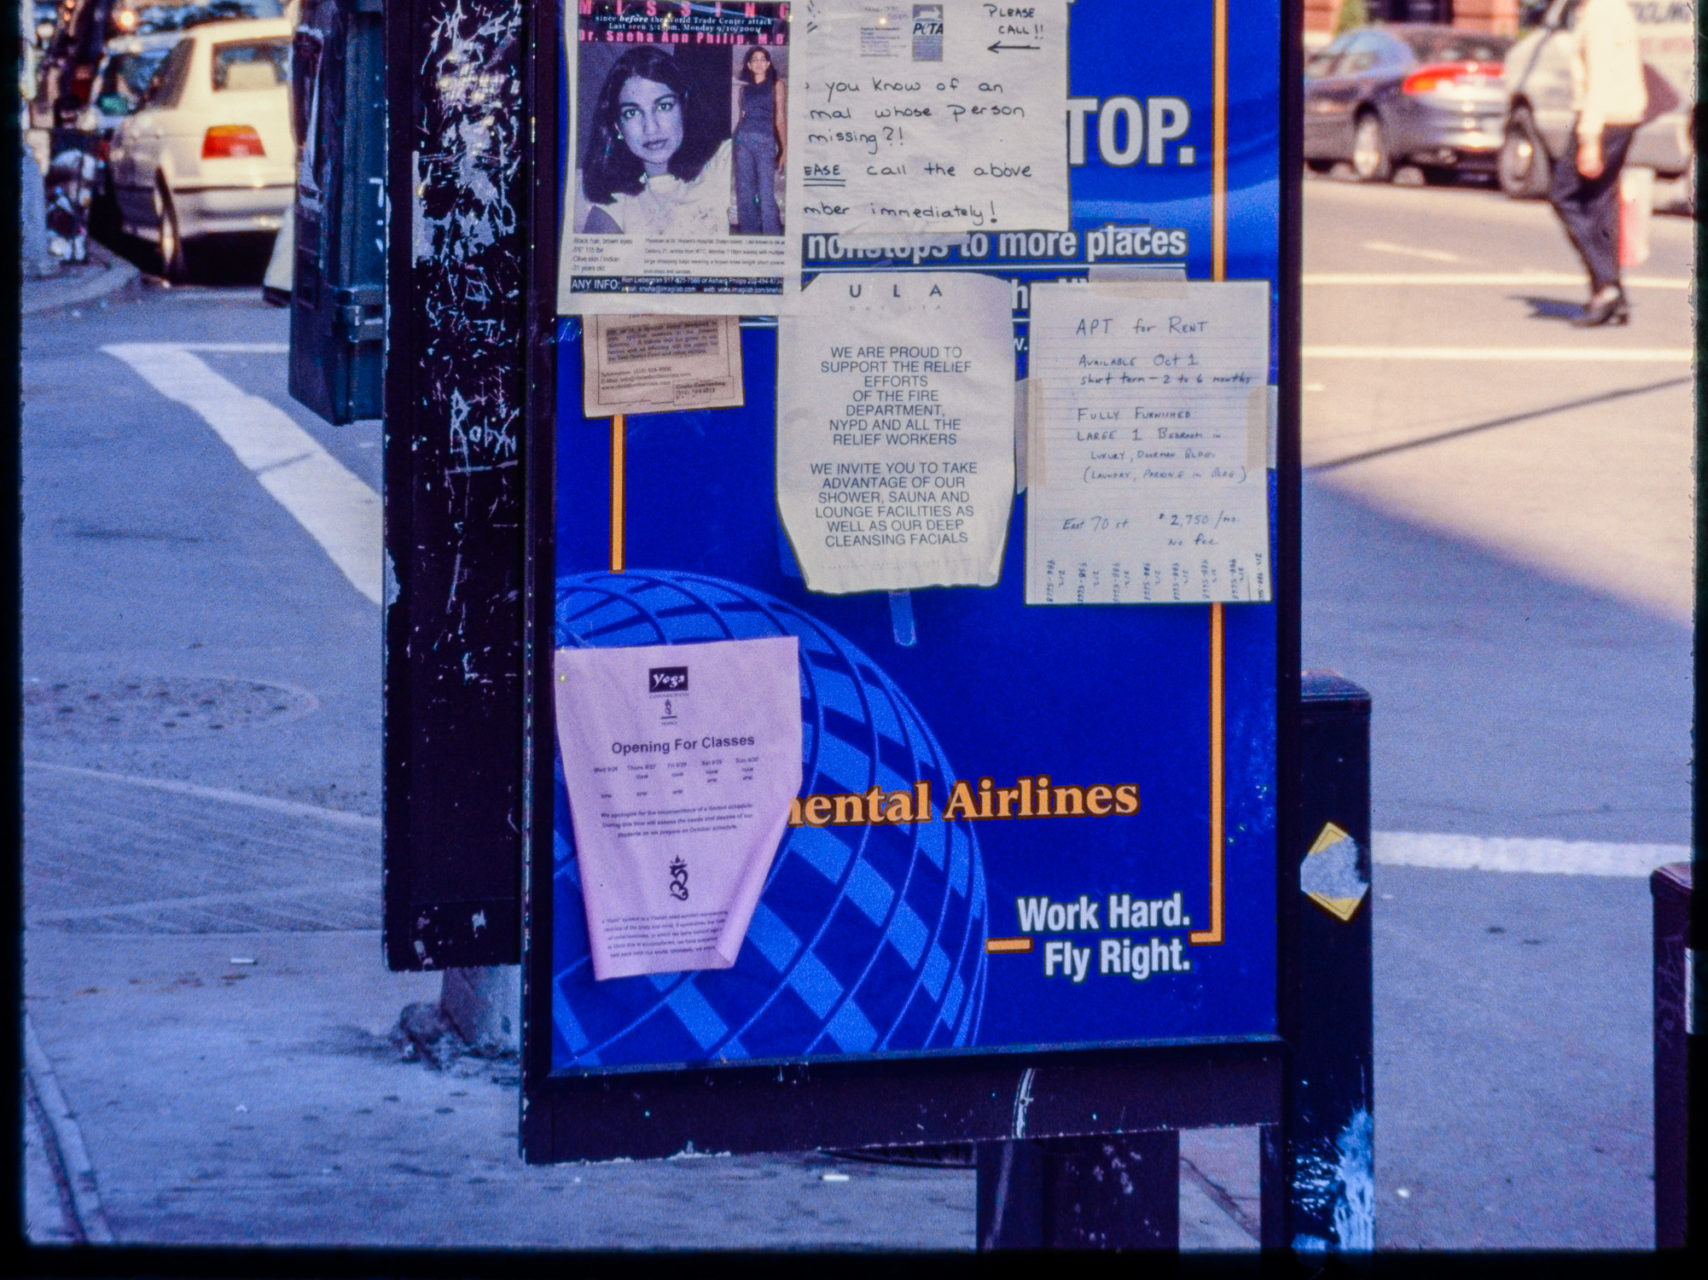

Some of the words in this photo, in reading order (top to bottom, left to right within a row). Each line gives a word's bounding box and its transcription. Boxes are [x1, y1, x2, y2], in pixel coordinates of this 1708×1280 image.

[983, 4, 1035, 18] PLEASE
[619, 14, 649, 23] before
[694, 17, 716, 25] Trade
[825, 82, 860, 103] you
[872, 77, 921, 91] know
[936, 77, 959, 91] of
[978, 83, 1003, 93] an
[810, 108, 851, 119] mal
[875, 107, 932, 118] whose
[867, 165, 906, 175] call
[924, 162, 955, 176] the
[974, 163, 1032, 177] above
[803, 202, 850, 215] mber
[1000, 231, 1077, 257] more
[1087, 225, 1187, 262] places
[571, 279, 592, 289] ANY
[594, 279, 620, 290] INFO:
[1076, 319, 1113, 336] APT
[1133, 318, 1156, 333] for
[831, 347, 852, 358] WE
[857, 346, 885, 358] ARE
[890, 346, 939, 358] PROUD
[944, 346, 962, 358] TO
[821, 361, 887, 373] SUPPORT
[892, 361, 919, 372] THE
[924, 361, 970, 373] RELIEF
[864, 375, 928, 388] EFFORTS
[853, 390, 872, 402] OF
[876, 390, 903, 401] THE
[909, 390, 938, 401] FIRE
[846, 404, 944, 417] DEPARTMENT,
[830, 419, 867, 431] NYPD
[872, 419, 901, 431] AND
[906, 419, 929, 430] ALL
[934, 419, 960, 430] THE
[833, 433, 881, 445] RELIEF
[886, 433, 957, 445] WORKERS
[810, 463, 832, 475] WE
[837, 463, 881, 474] INVITE
[886, 462, 915, 474] YOU
[919, 462, 938, 474] TO
[942, 462, 976, 473] TAKE
[823, 477, 906, 489] ADVANTAGE
[912, 476, 931, 488] OF
[935, 476, 965, 488] OUR
[819, 491, 883, 504] SHOWER,
[889, 491, 936, 503] SAUNA
[941, 491, 969, 502] AND
[816, 506, 872, 518] LOUNGE
[878, 505, 951, 517] FACILITIES
[956, 505, 974, 517] AS
[827, 521, 864, 532] WELL
[869, 520, 887, 531] AS
[891, 519, 922, 531] OUR
[926, 519, 964, 531] DEEP
[825, 532, 905, 547] CLEANSING
[910, 532, 968, 544] FACIALS
[612, 738, 670, 755] Opening
[674, 738, 698, 751] For
[701, 735, 756, 749] Classes
[944, 776, 1140, 819] Airlines
[1017, 896, 1099, 932] Work
[1109, 893, 1191, 929] Hard.
[1044, 942, 1091, 982] Fly
[1101, 938, 1191, 980] Right.
